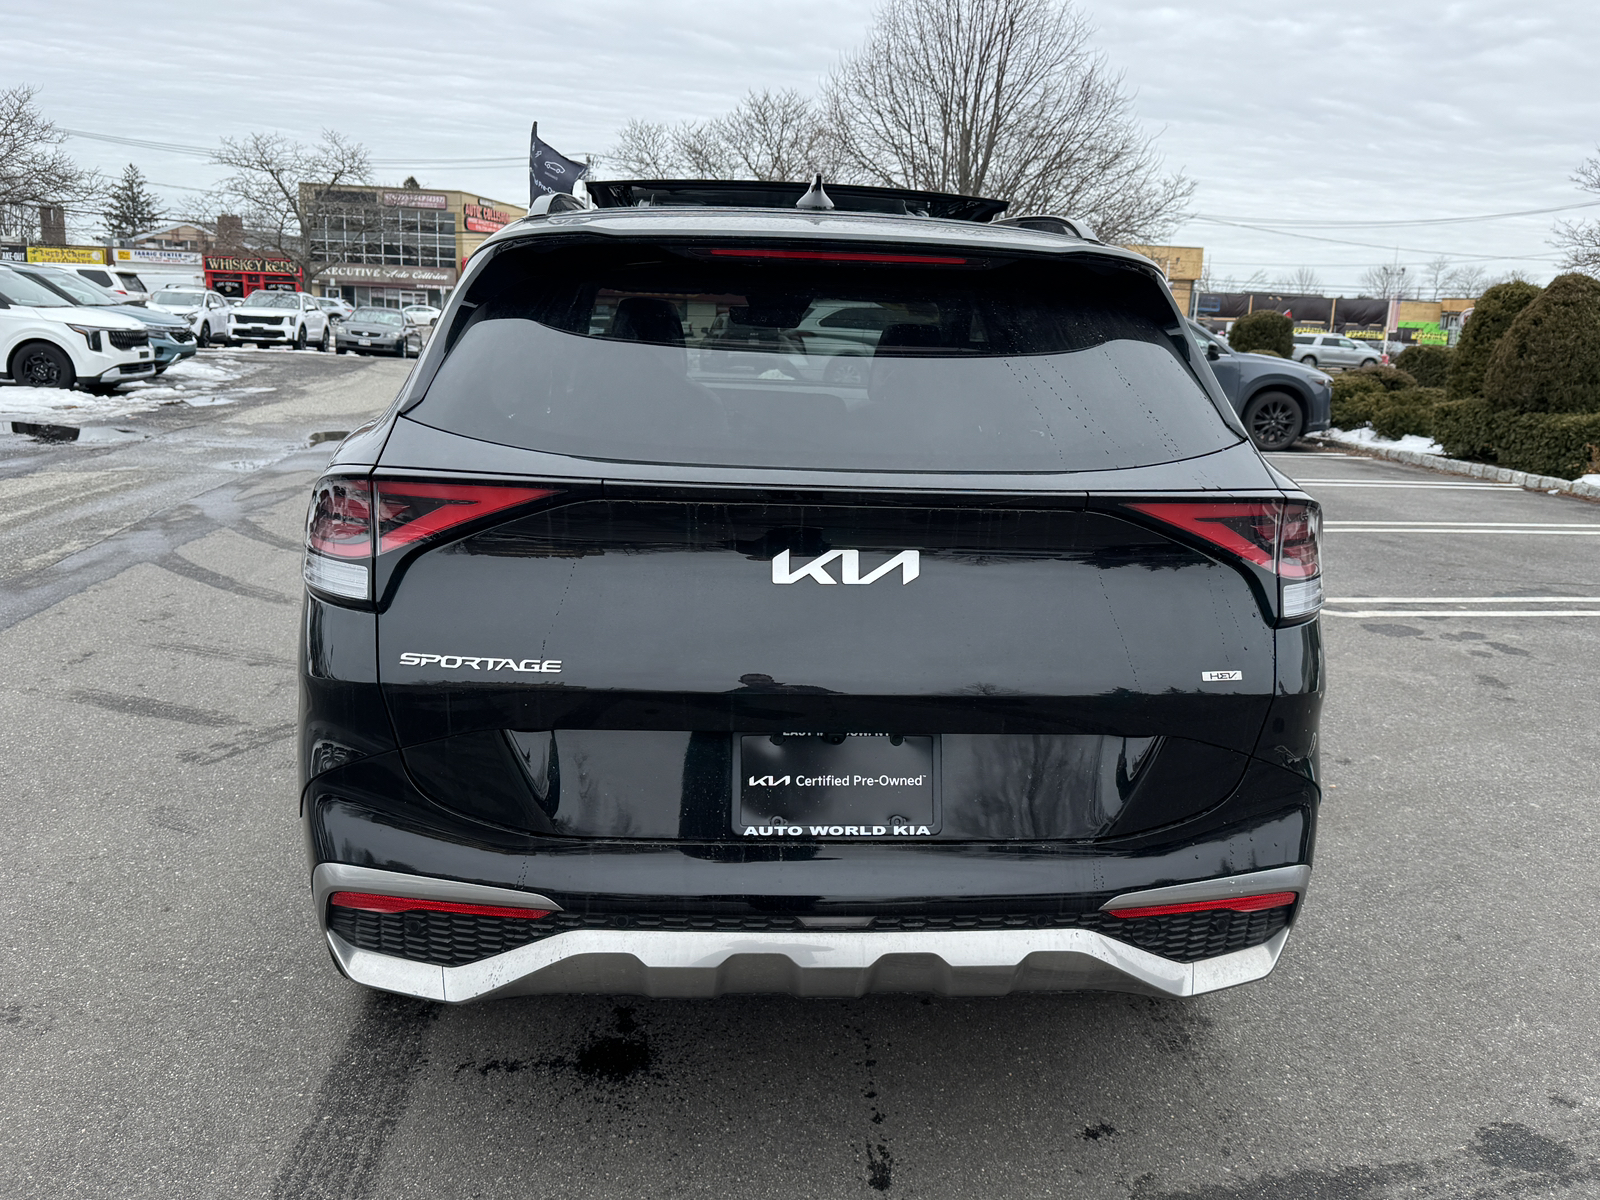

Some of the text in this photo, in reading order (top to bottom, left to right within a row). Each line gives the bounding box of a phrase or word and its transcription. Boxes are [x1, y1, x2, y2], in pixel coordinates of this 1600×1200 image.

[208, 258, 262, 271] WHISKEY
[412, 271, 448, 281] Collision
[772, 548, 920, 585] KIA
[399, 652, 562, 674] SPORTAGE
[1209, 671, 1238, 680] HEV
[748, 775, 791, 787] KIA
[796, 774, 850, 787] Certified
[743, 825, 931, 836] AUTO WORLD KIA
